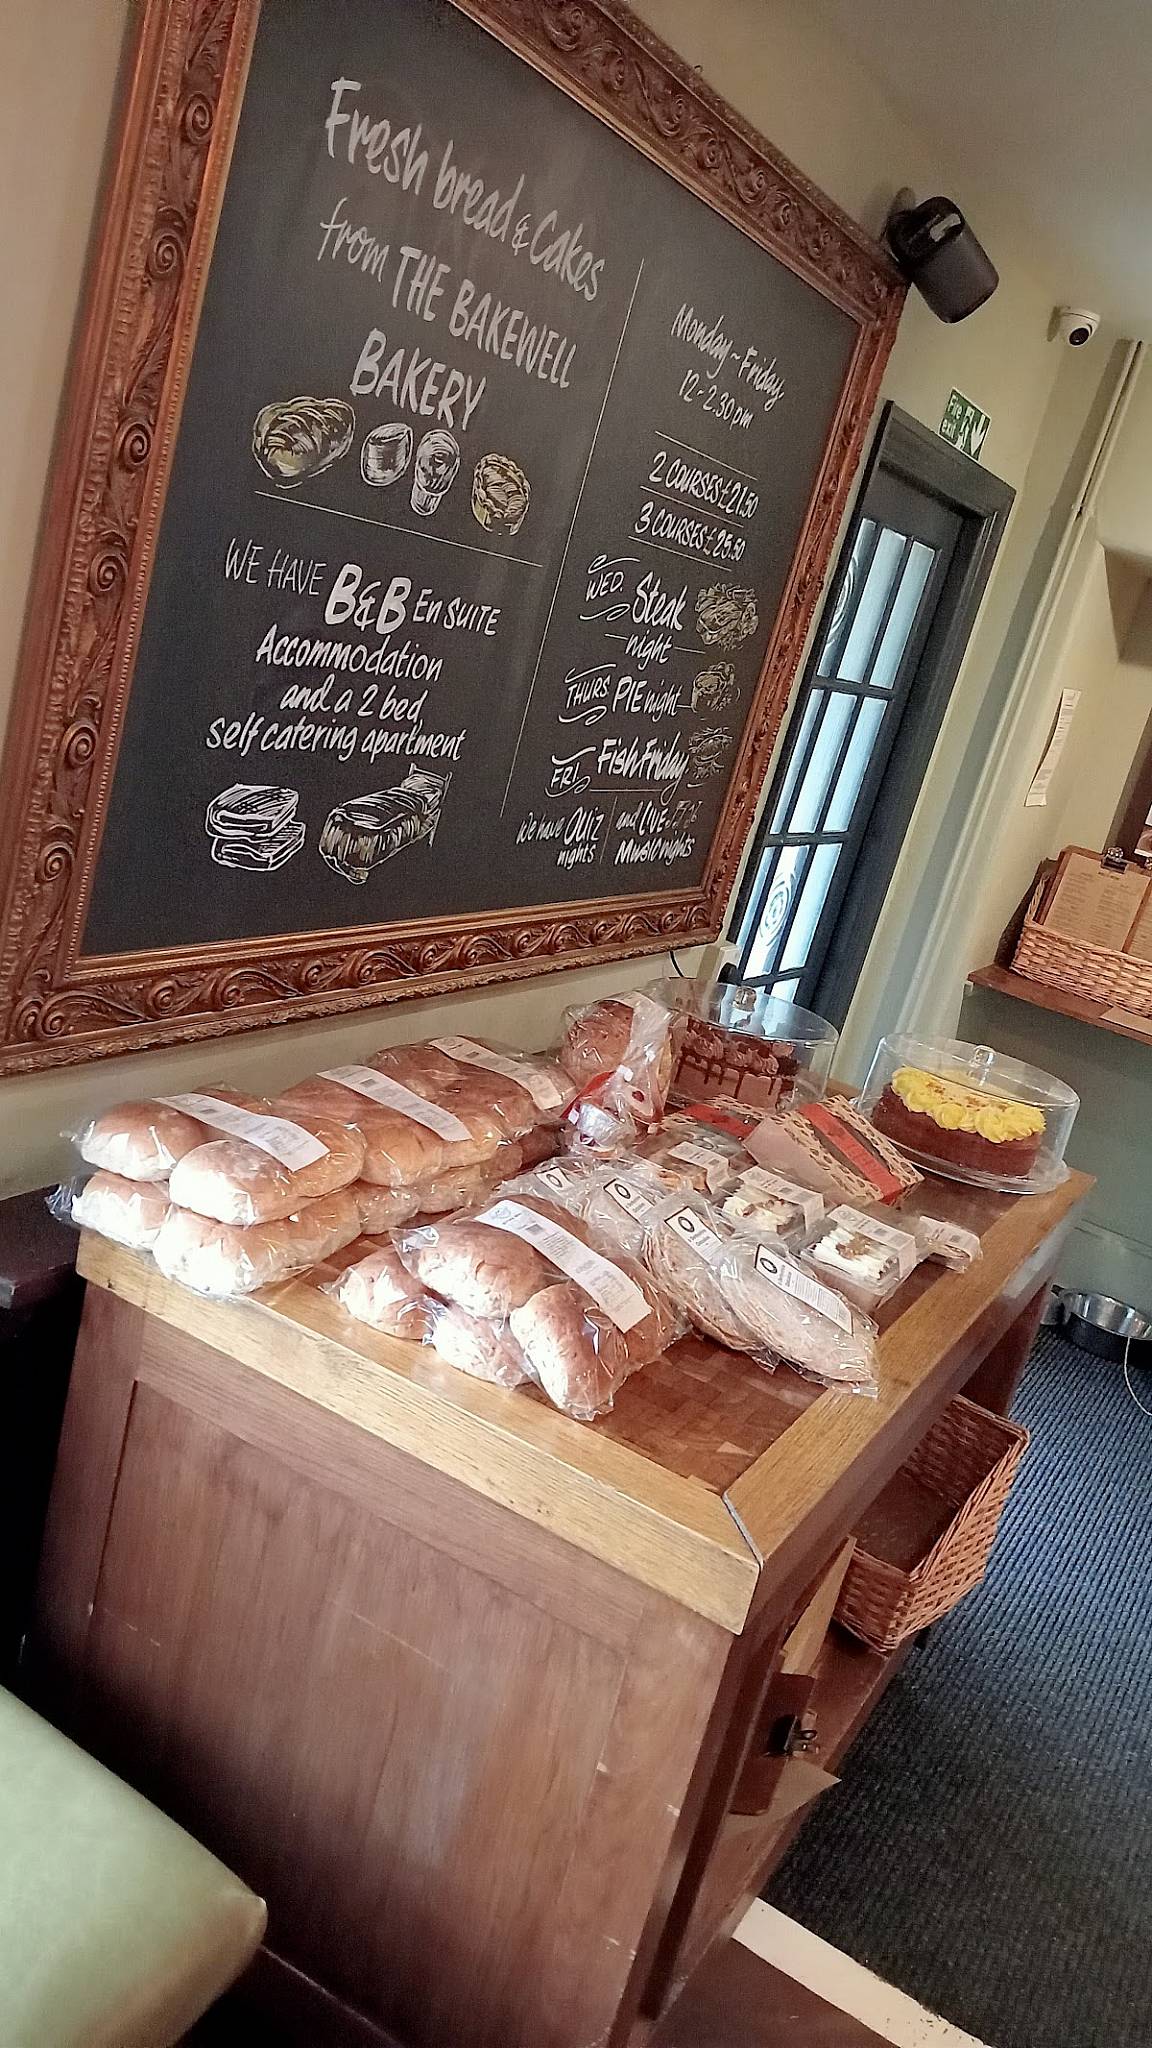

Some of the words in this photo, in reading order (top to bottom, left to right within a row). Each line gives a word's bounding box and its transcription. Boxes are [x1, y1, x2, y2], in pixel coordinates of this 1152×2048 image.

[325, 76, 428, 195] Fresh
[433, 140, 525, 242] bread
[511, 214, 532, 256] &
[529, 210, 606, 301] Cakes
[317, 197, 391, 282] from
[392, 246, 451, 322] THE
[449, 279, 578, 389] BAKEWELL
[349, 328, 487, 431] BAKERY
[941, 418, 957, 440] exit
[947, 393, 963, 420] Fire
[649, 451, 667, 483] 2
[665, 458, 723, 504] COURSES
[634, 501, 654, 534] 3
[651, 508, 708, 550] COURSES
[225, 537, 264, 584] WE
[267, 549, 327, 596] HAVE
[324, 563, 412, 635] B&B
[443, 597, 501, 636] SUITE
[632, 571, 688, 631] Steak
[255, 623, 444, 682] Accommodation
[625, 629, 673, 671] night
[280, 673, 335, 713] and
[334, 688, 354, 714] a
[357, 683, 379, 717] 2
[612, 676, 648, 713] PIE
[644, 679, 683, 723] night
[205, 712, 265, 757] self
[260, 716, 359, 762] catering
[361, 719, 467, 764] apartment
[597, 736, 641, 779] Fish
[516, 811, 537, 845] We
[536, 813, 565, 841] have
[615, 800, 644, 831] and
[639, 799, 669, 836] LIVE
[557, 842, 597, 870] nights
